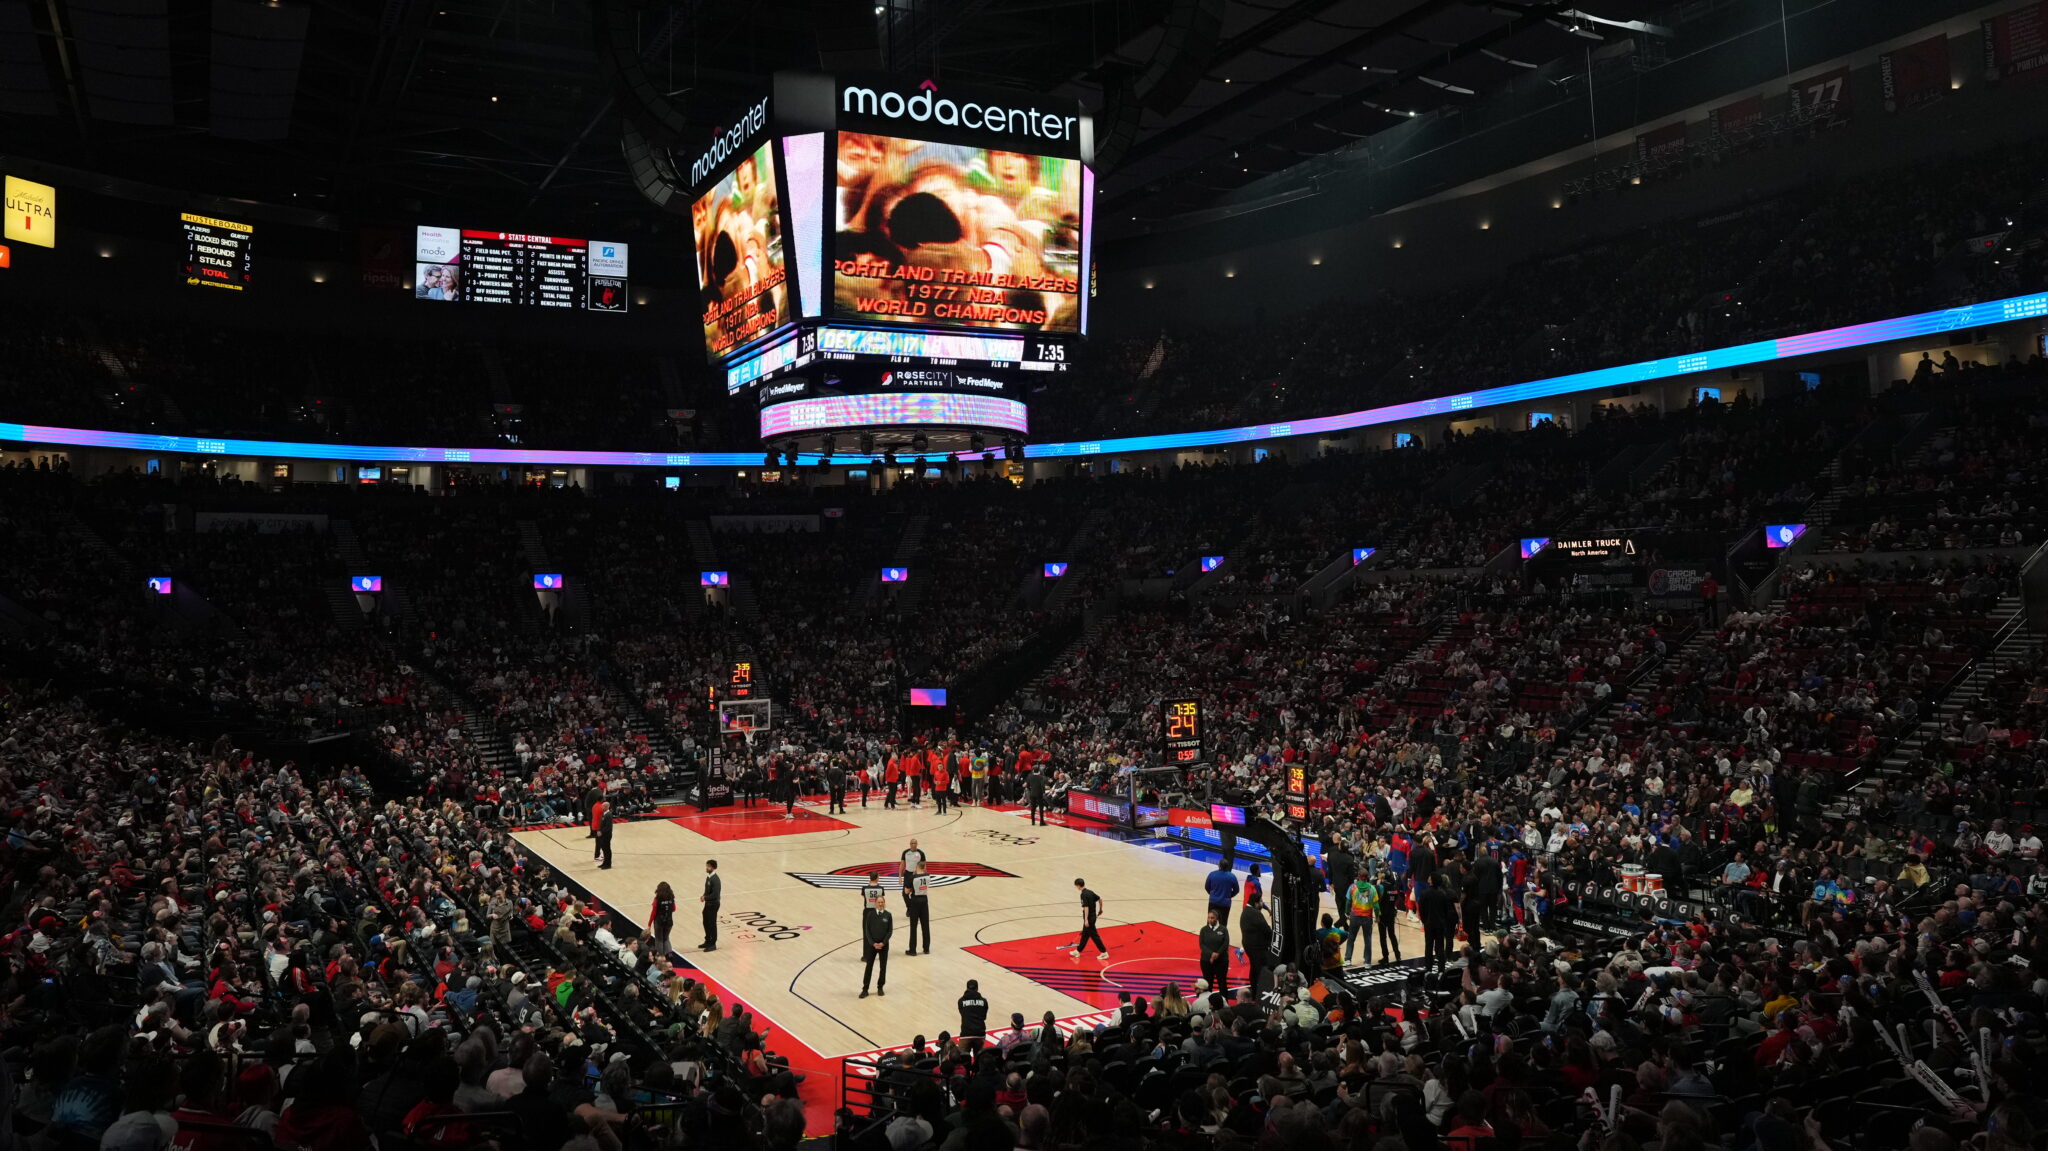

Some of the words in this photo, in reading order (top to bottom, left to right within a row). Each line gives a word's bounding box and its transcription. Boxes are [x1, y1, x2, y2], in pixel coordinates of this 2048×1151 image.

[1880, 56, 1895, 98] SCHONELY
[1808, 77, 1843, 112] 77
[843, 86, 1077, 141] modacenter
[5, 197, 53, 219] ULTRA
[183, 224, 211, 233] BLAZERS
[185, 214, 249, 232] HUSTLEBOARD
[187, 231, 194, 240] 2
[194, 233, 220, 245] BLOCKED
[220, 238, 239, 248] SHOTS
[230, 232, 250, 240] GUEST
[508, 233, 526, 242] STATS
[527, 235, 552, 244] CENTRAL
[196, 244, 236, 258] REBOUNDS
[420, 246, 446, 256] moda
[199, 255, 233, 268] STEALS
[244, 262, 251, 271] 2
[202, 268, 229, 280] TOTAL
[942, 270, 1078, 293] TRAILBLAZERS
[735, 269, 786, 308] TRAILBLAZERS
[907, 283, 958, 301] 1977
[967, 287, 1007, 305] NBA
[725, 309, 742, 329] 1977
[745, 301, 760, 318] NBA
[856, 297, 927, 317] WORLD
[934, 303, 1047, 325] CHAMPIONS
[712, 330, 735, 352] WORLD
[736, 309, 777, 340] CHAMPIONS
[802, 333, 814, 354] 7:35
[1037, 344, 1064, 361] 7:35
[1557, 540, 1592, 549] DAIMLER
[1595, 538, 1621, 548] TRUCK
[1667, 569, 1696, 577] GARCIA
[1669, 583, 1692, 592] BAND
[736, 663, 750, 671] 7:35
[733, 670, 749, 682] 24
[1174, 703, 1196, 715] 7:35
[1170, 715, 1195, 738] 24
[1177, 740, 1200, 748] TISSOT
[1291, 768, 1304, 780] 7:35
[1291, 779, 1302, 792] 24
[1567, 882, 1576, 891] G
[1585, 886, 1594, 895] G
[870, 890, 878, 898] 52
[1603, 889, 1612, 898] G
[1621, 893, 1630, 902] G
[1640, 897, 1649, 906] G
[1659, 900, 1668, 910] G
[1679, 905, 1688, 914] G
[729, 911, 800, 941] moda
[1572, 919, 1603, 931] GATORADE
[962, 999, 985, 1007] PORTLAND
[882, 1056, 897, 1064] PHOTO
